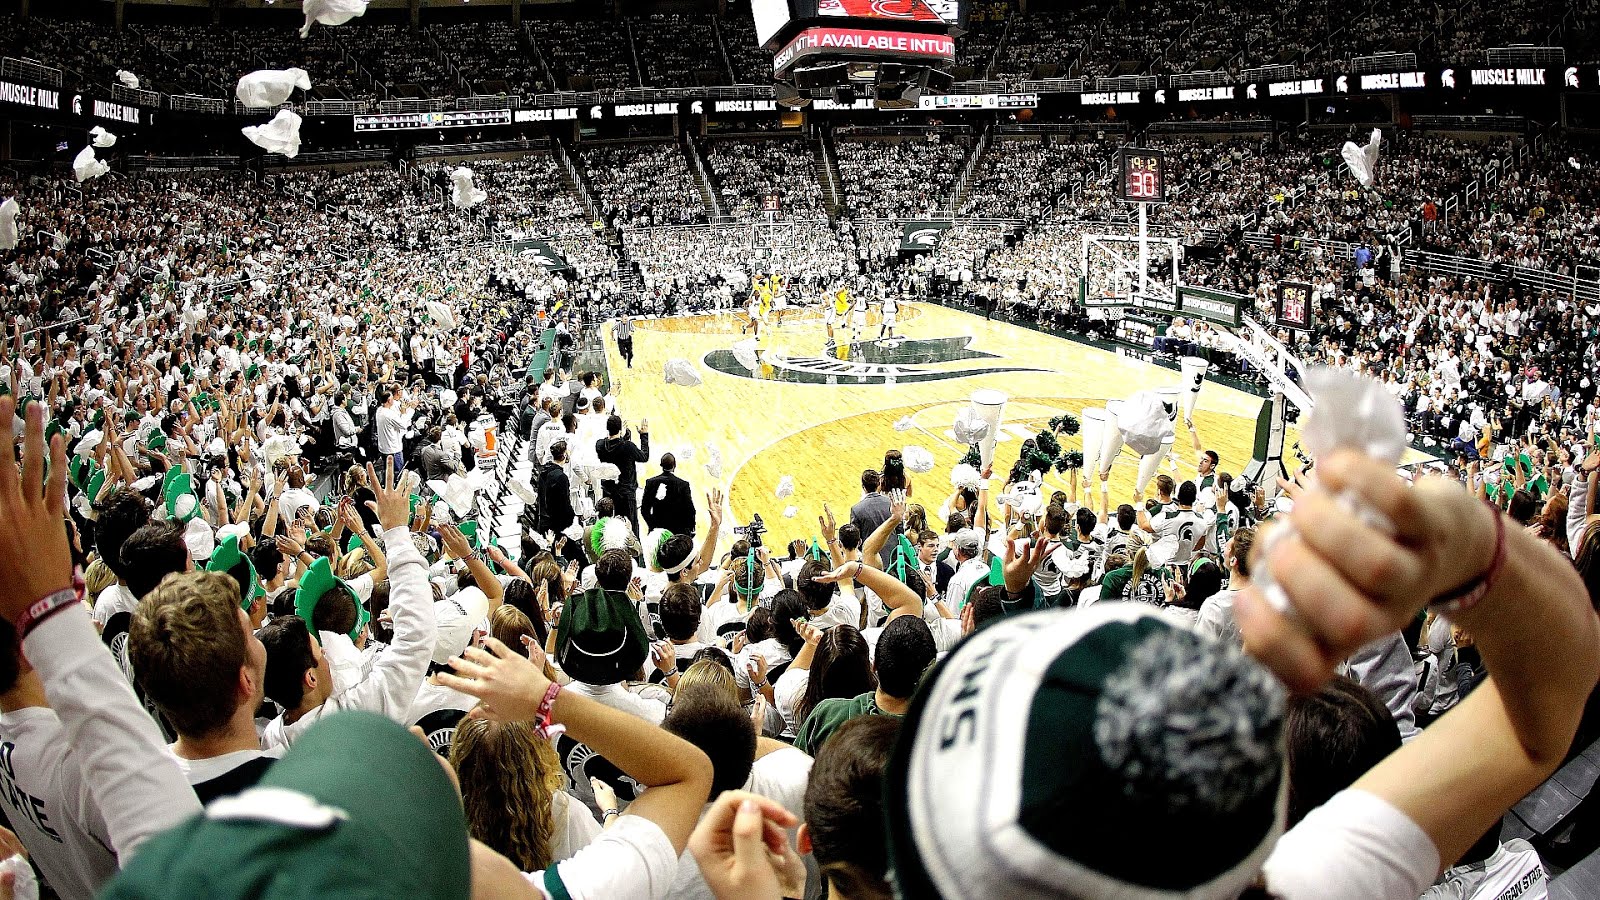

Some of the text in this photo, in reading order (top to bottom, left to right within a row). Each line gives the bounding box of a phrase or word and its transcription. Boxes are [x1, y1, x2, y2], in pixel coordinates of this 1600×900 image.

[795, 35, 818, 53] WITH
[821, 33, 908, 51] AVAILABLE
[1361, 72, 1425, 89] MUSCLE MILK
[1471, 69, 1545, 84] MUSCLE MILK
[0, 81, 59, 109] MUSCLE MILK
[1178, 87, 1234, 101] MUSCLE MILK
[1269, 79, 1323, 96] MUSCLE MILK
[1081, 92, 1140, 104] MUSCLE MILK
[94, 100, 139, 123] MUSCLE MILK
[614, 103, 679, 116] MUSCLE MILK
[715, 100, 777, 112] MUSCLE MILK
[515, 109, 552, 122] MUSCLE
[553, 107, 578, 120] MILK
[1129, 157, 1157, 171] 19:12
[1130, 172, 1155, 197] 30
